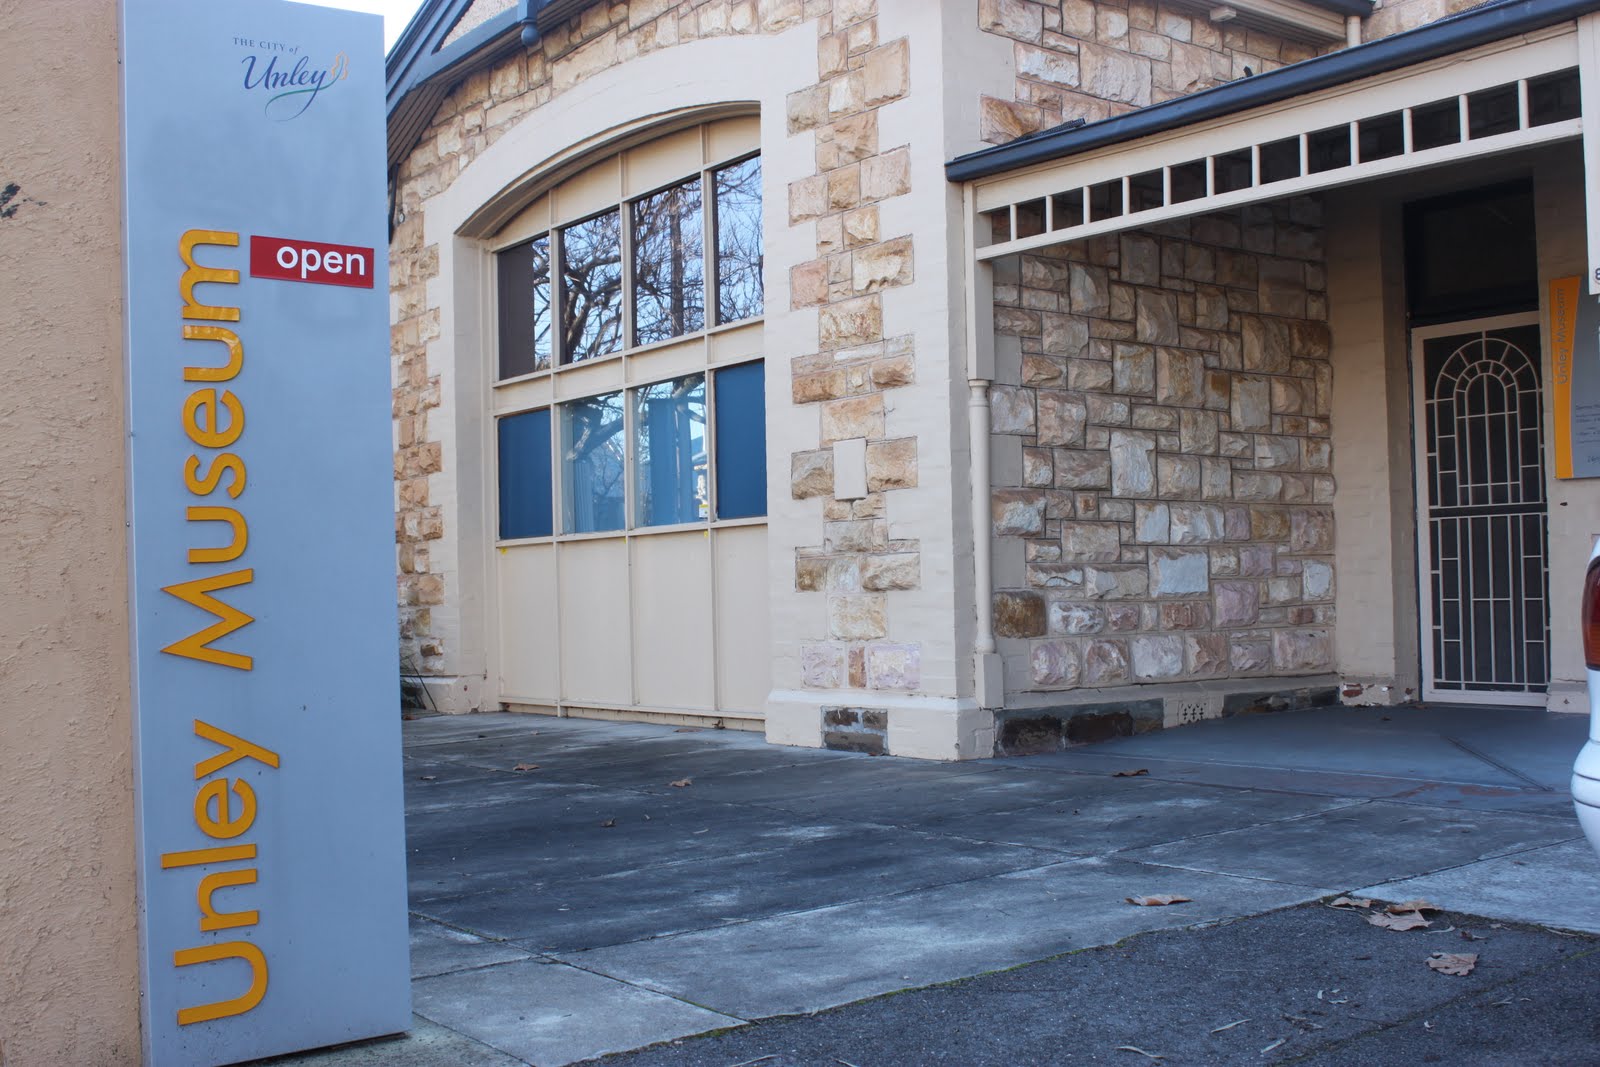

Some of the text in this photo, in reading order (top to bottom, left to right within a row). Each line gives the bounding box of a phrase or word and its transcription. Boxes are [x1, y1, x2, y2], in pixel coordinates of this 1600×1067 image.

[232, 37, 300, 54] THE CITY of
[241, 55, 327, 121] Unley
[276, 246, 365, 279] open
[1553, 288, 1568, 385] Unley Museum
[160, 228, 280, 1026] Unley Museum
